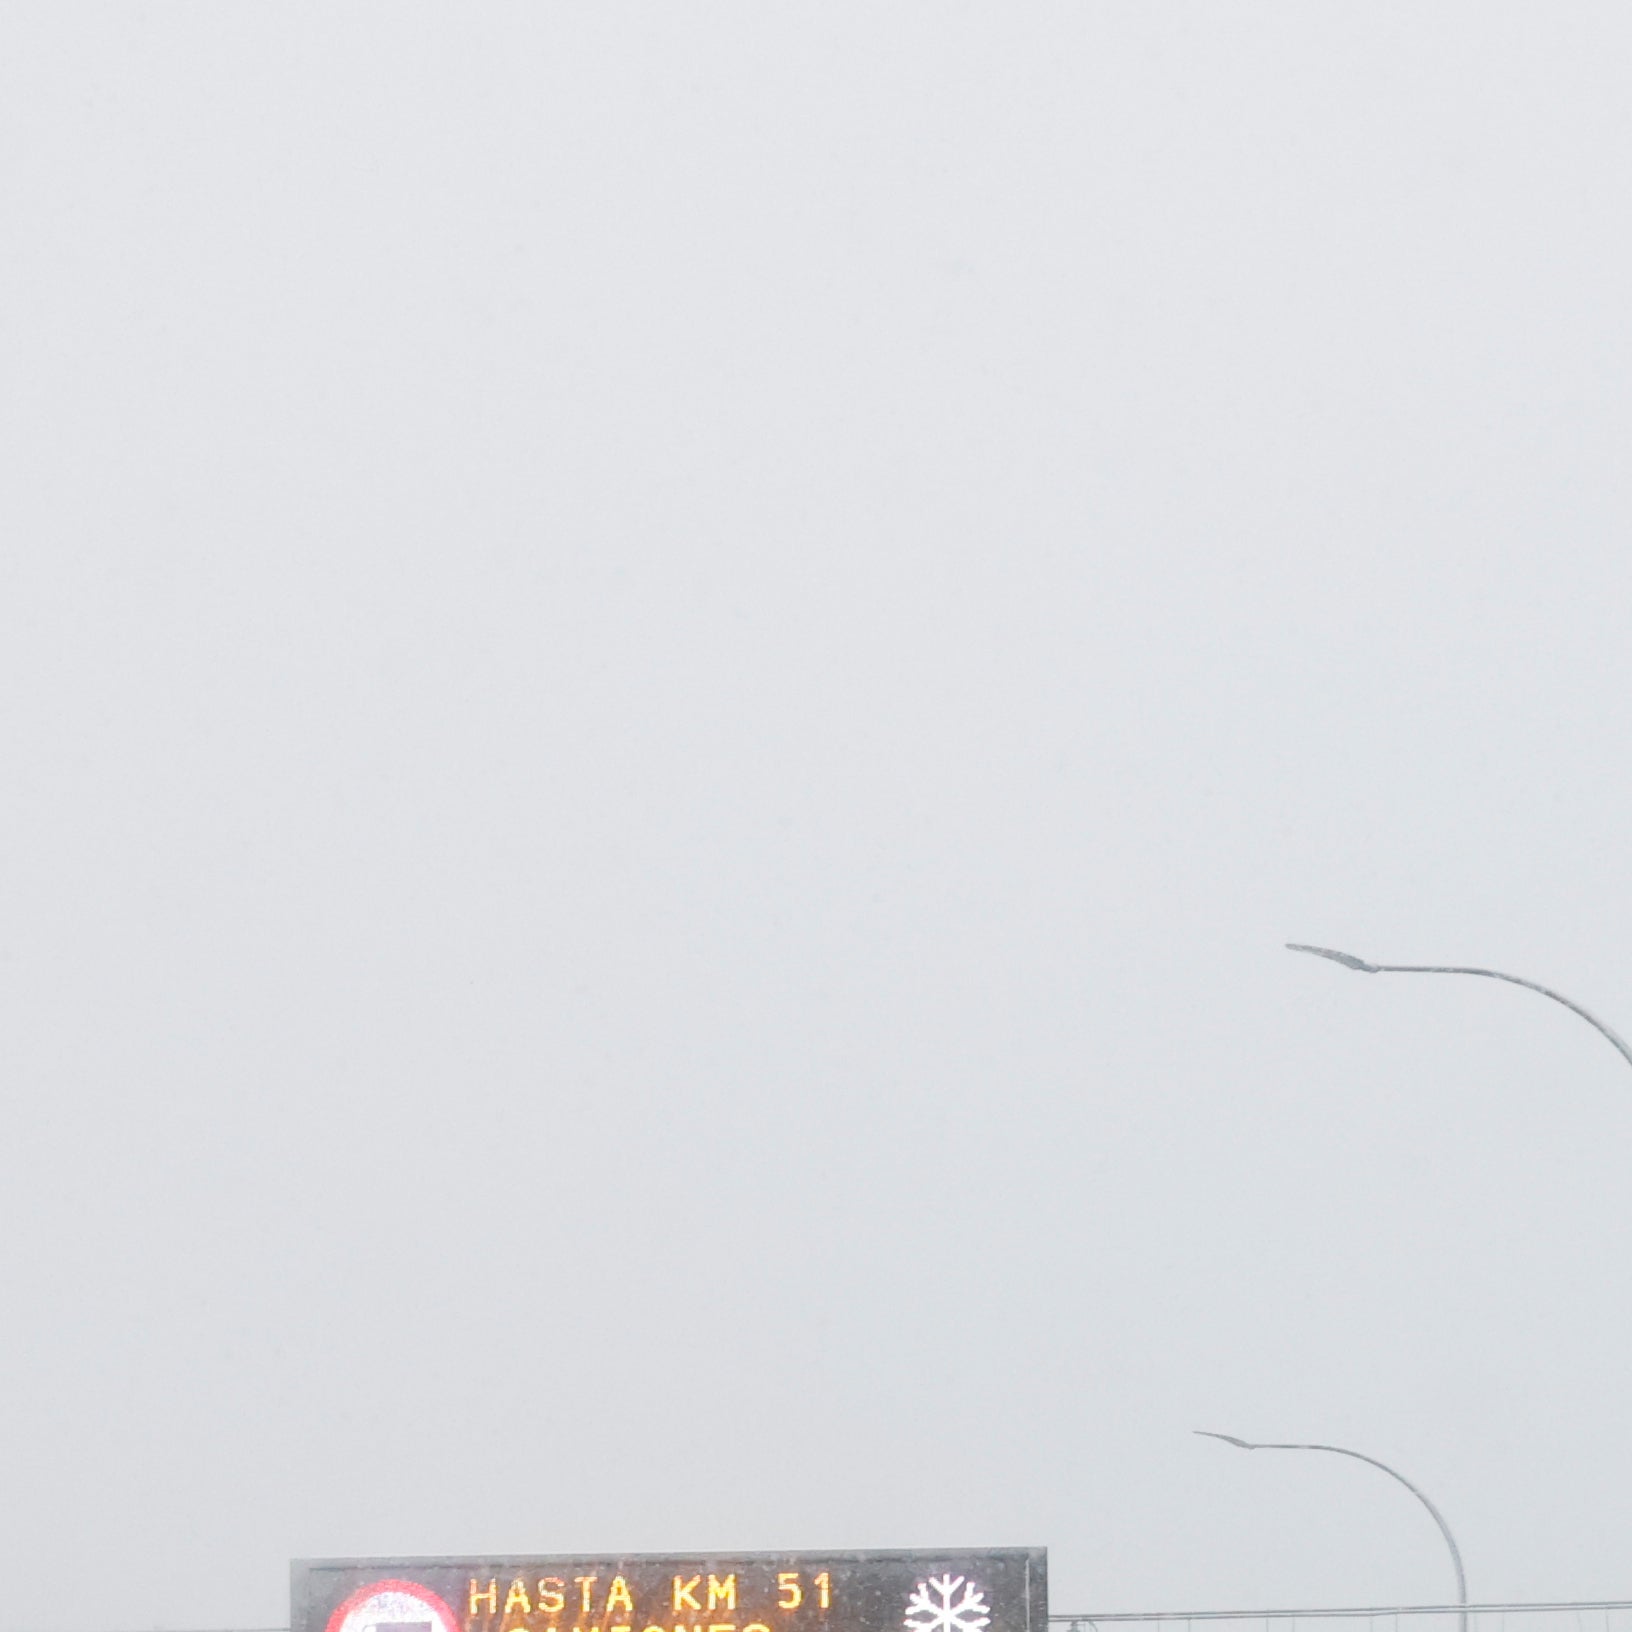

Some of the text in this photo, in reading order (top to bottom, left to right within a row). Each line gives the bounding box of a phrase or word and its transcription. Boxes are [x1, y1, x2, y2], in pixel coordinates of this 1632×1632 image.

[469, 1571, 831, 1614] HASTA KM 51
